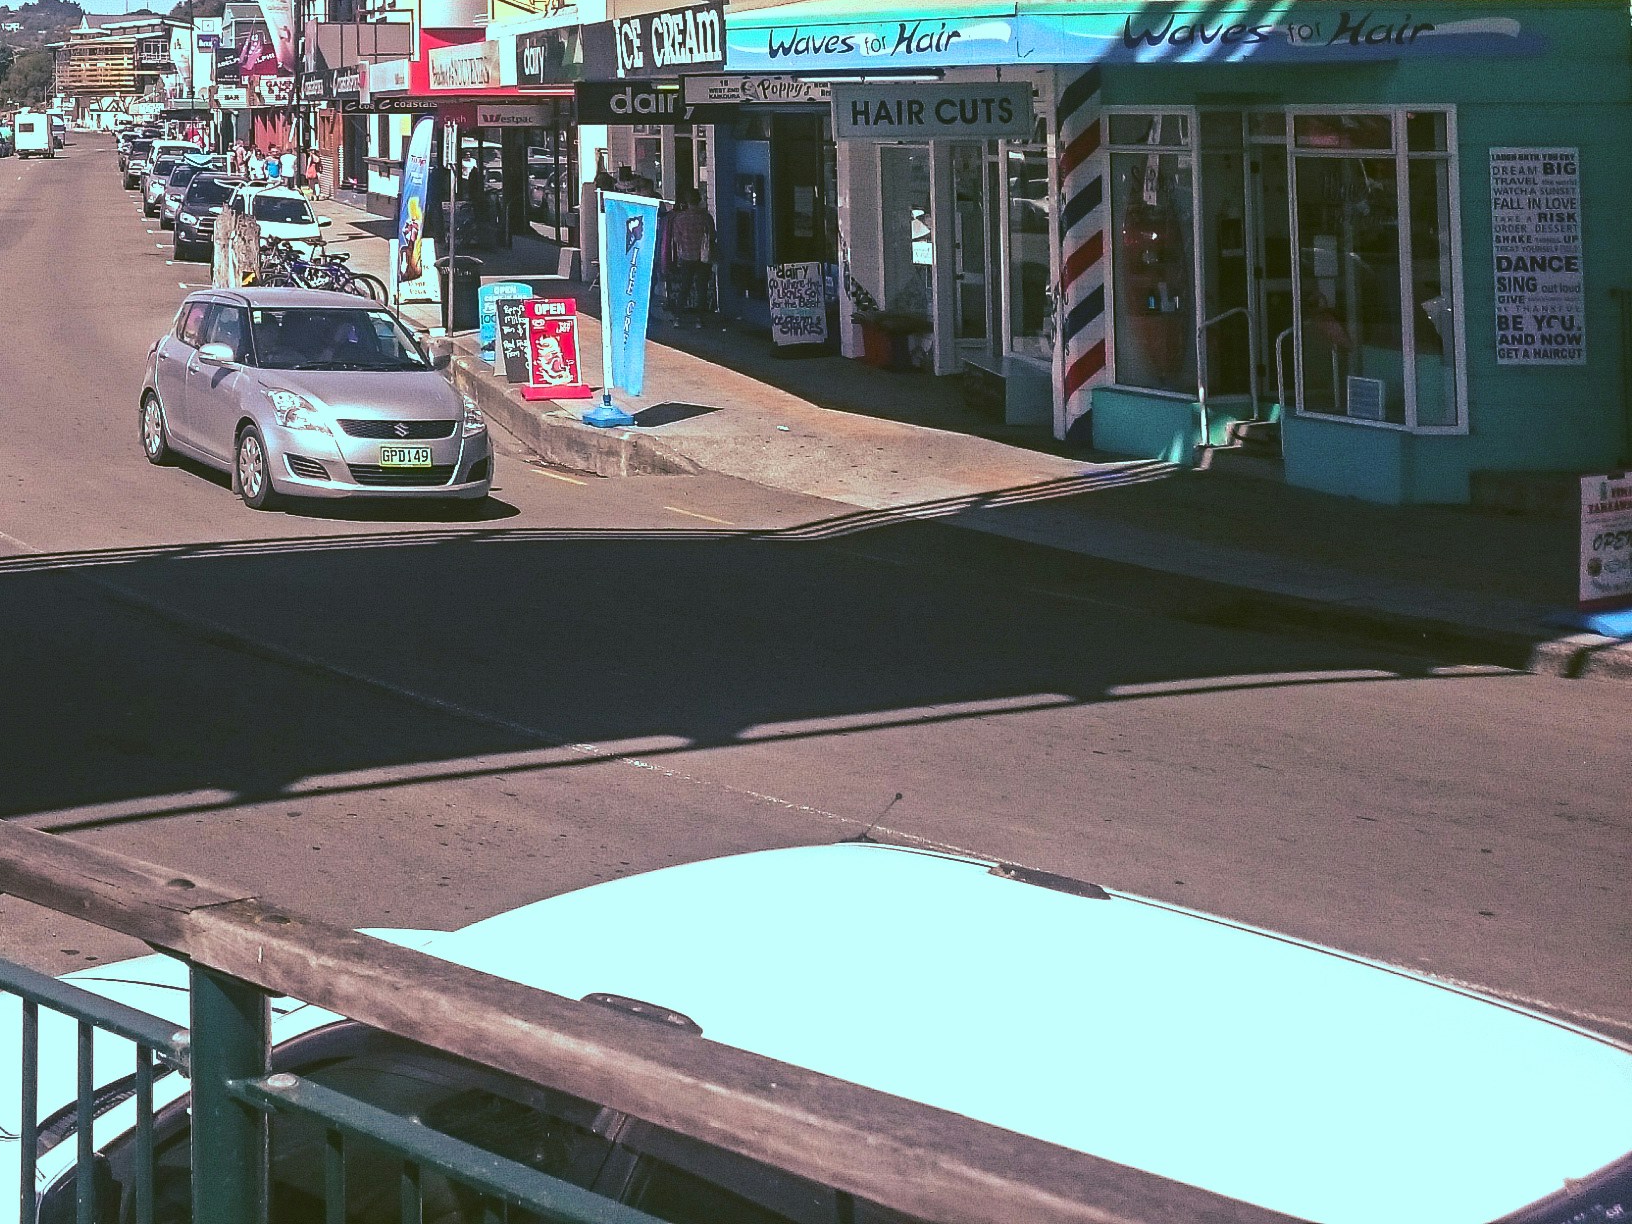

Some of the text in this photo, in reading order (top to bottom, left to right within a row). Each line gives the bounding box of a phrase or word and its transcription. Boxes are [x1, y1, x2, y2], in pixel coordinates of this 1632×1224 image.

[1122, 13, 1272, 49] Waves
[1324, 10, 1436, 47] Hair
[767, 20, 962, 59] Waves for Hair
[612, 18, 644, 79] ICE
[756, 77, 812, 100] Poppy's
[850, 96, 1014, 126] HAIR CUTS
[1492, 162, 1577, 176] DREAM BIG
[1494, 177, 1538, 185] TRAVEL
[1493, 197, 1577, 210] FALL IN LOVE
[1537, 212, 1577, 223] RISK
[1494, 224, 1578, 233] ORDER DESSERT
[1495, 235, 1532, 244] SHAKE
[1495, 255, 1579, 273] DANCE
[1496, 276, 1537, 293] SING
[1497, 295, 1525, 304] GIVE
[534, 302, 566, 315] OPEN
[1497, 315, 1524, 332] BE
[1498, 334, 1582, 346] AND NOW
[1498, 348, 1583, 359] GET A HAIRCUT
[382, 448, 430, 464] GPD149
